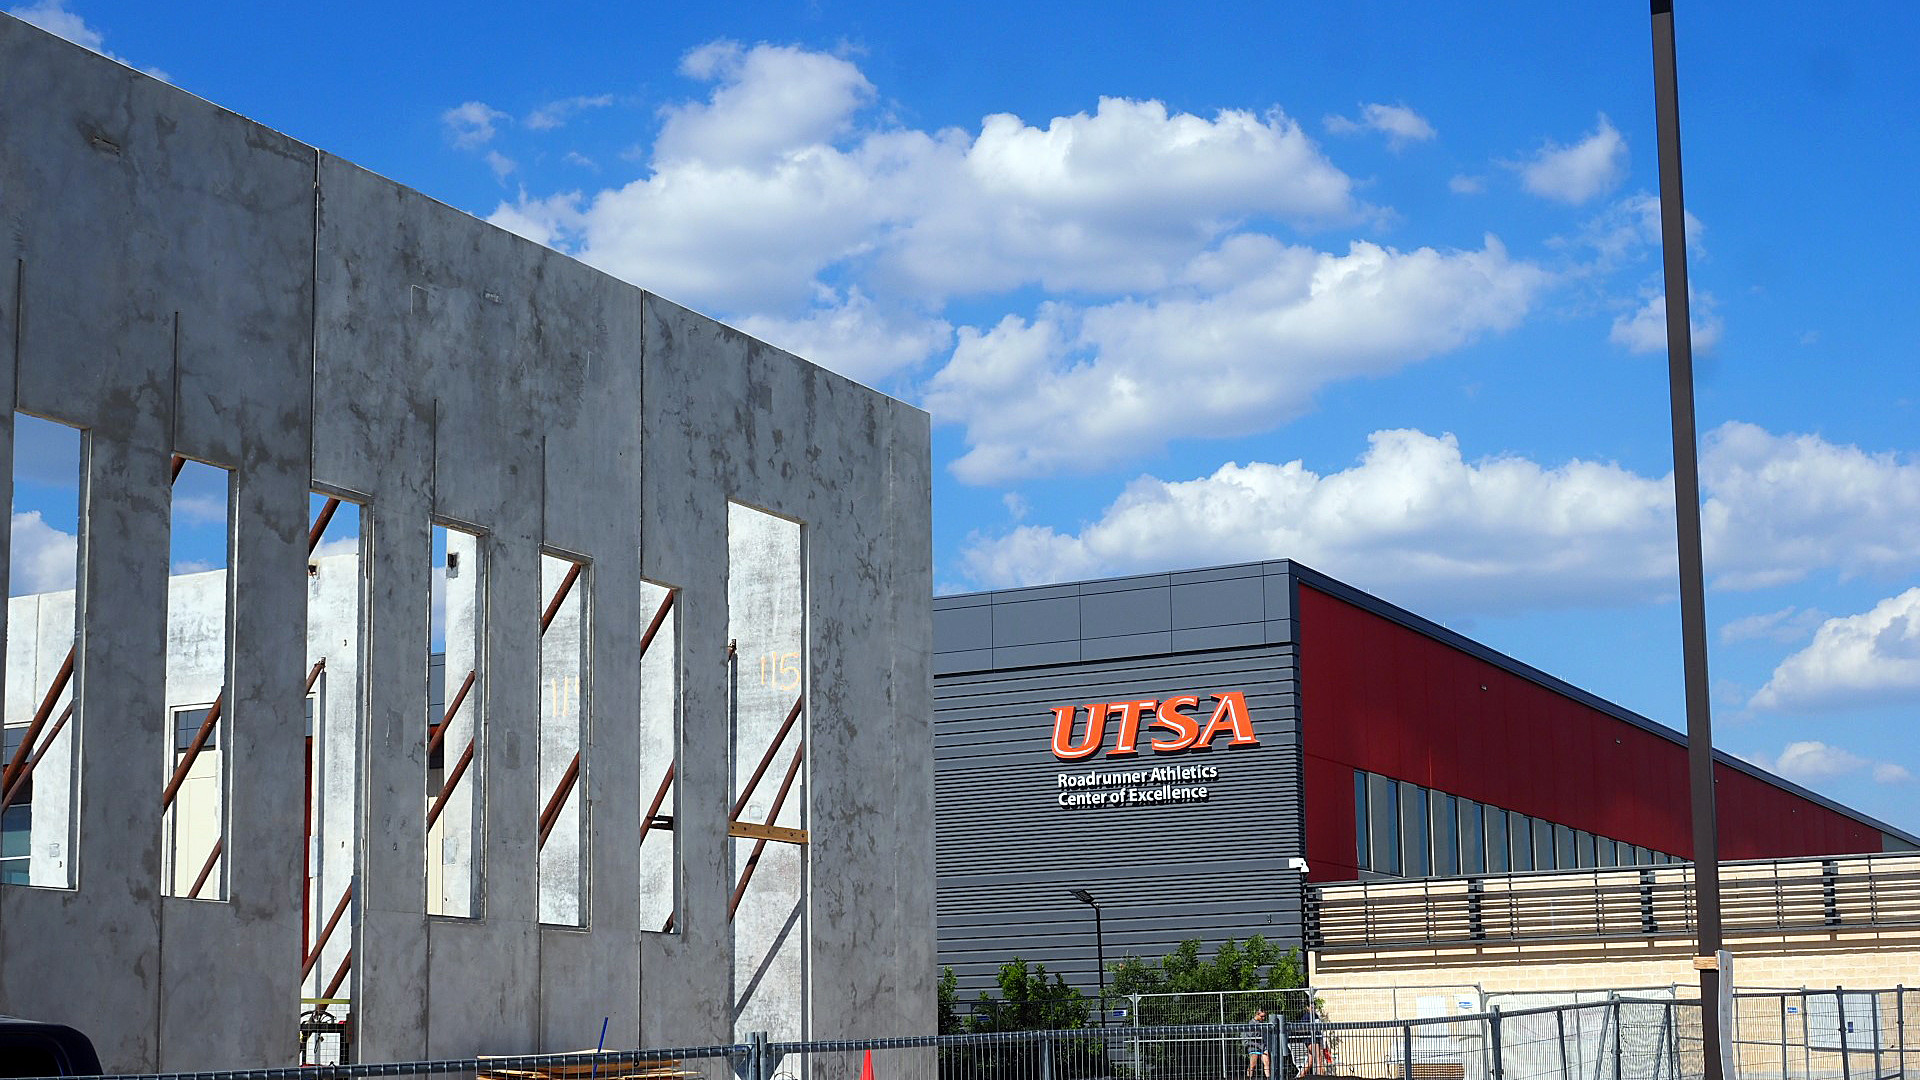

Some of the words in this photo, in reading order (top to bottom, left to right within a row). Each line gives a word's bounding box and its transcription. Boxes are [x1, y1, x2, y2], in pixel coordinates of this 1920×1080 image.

[1050, 691, 1260, 760] UTSA
[1058, 771, 1148, 788] Roadrunner
[1150, 765, 1218, 782] Athletics
[1058, 791, 1108, 806] Center
[1109, 788, 1126, 803] of
[1128, 784, 1208, 802] Excellence
